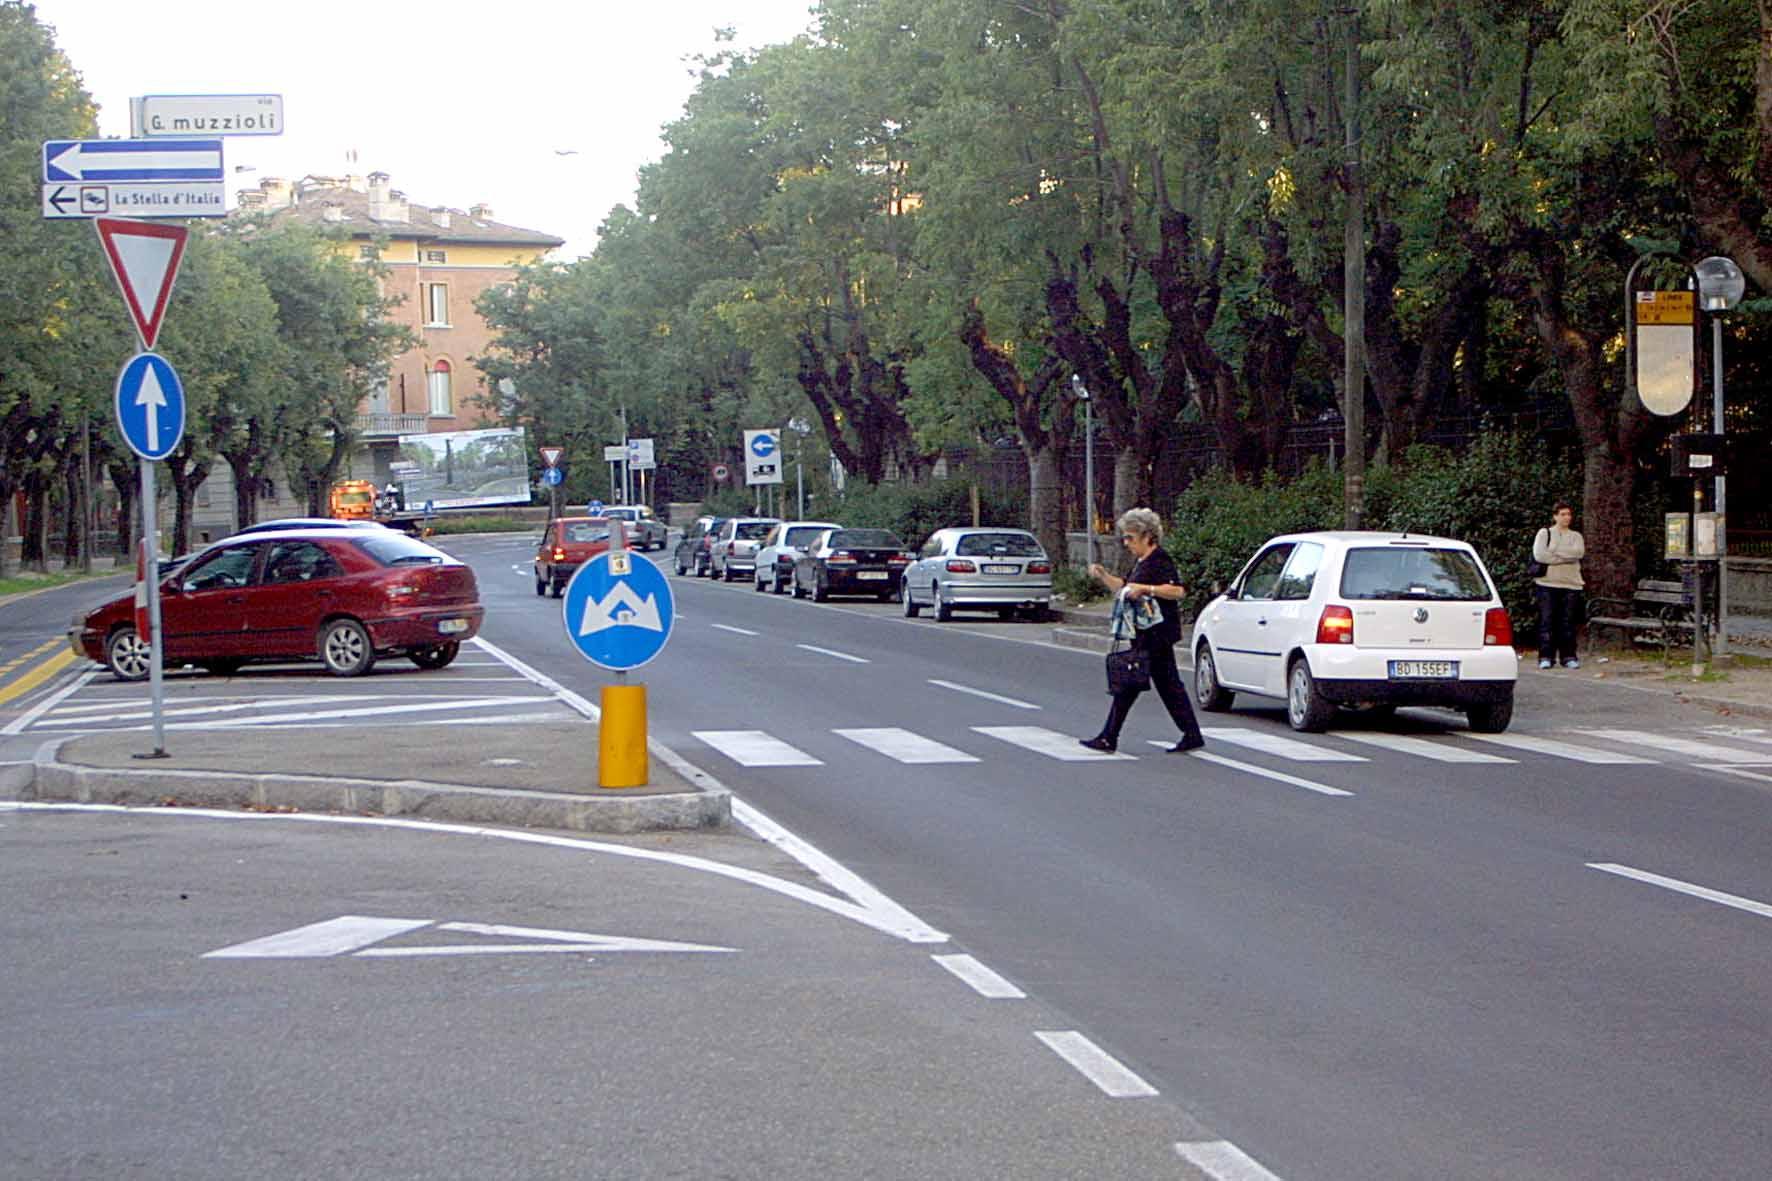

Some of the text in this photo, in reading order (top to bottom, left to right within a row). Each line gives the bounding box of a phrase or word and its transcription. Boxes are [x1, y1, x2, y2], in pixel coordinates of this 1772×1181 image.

[151, 112, 275, 130] G. muzzioli
[115, 192, 220, 205] La Stella d'Italia
